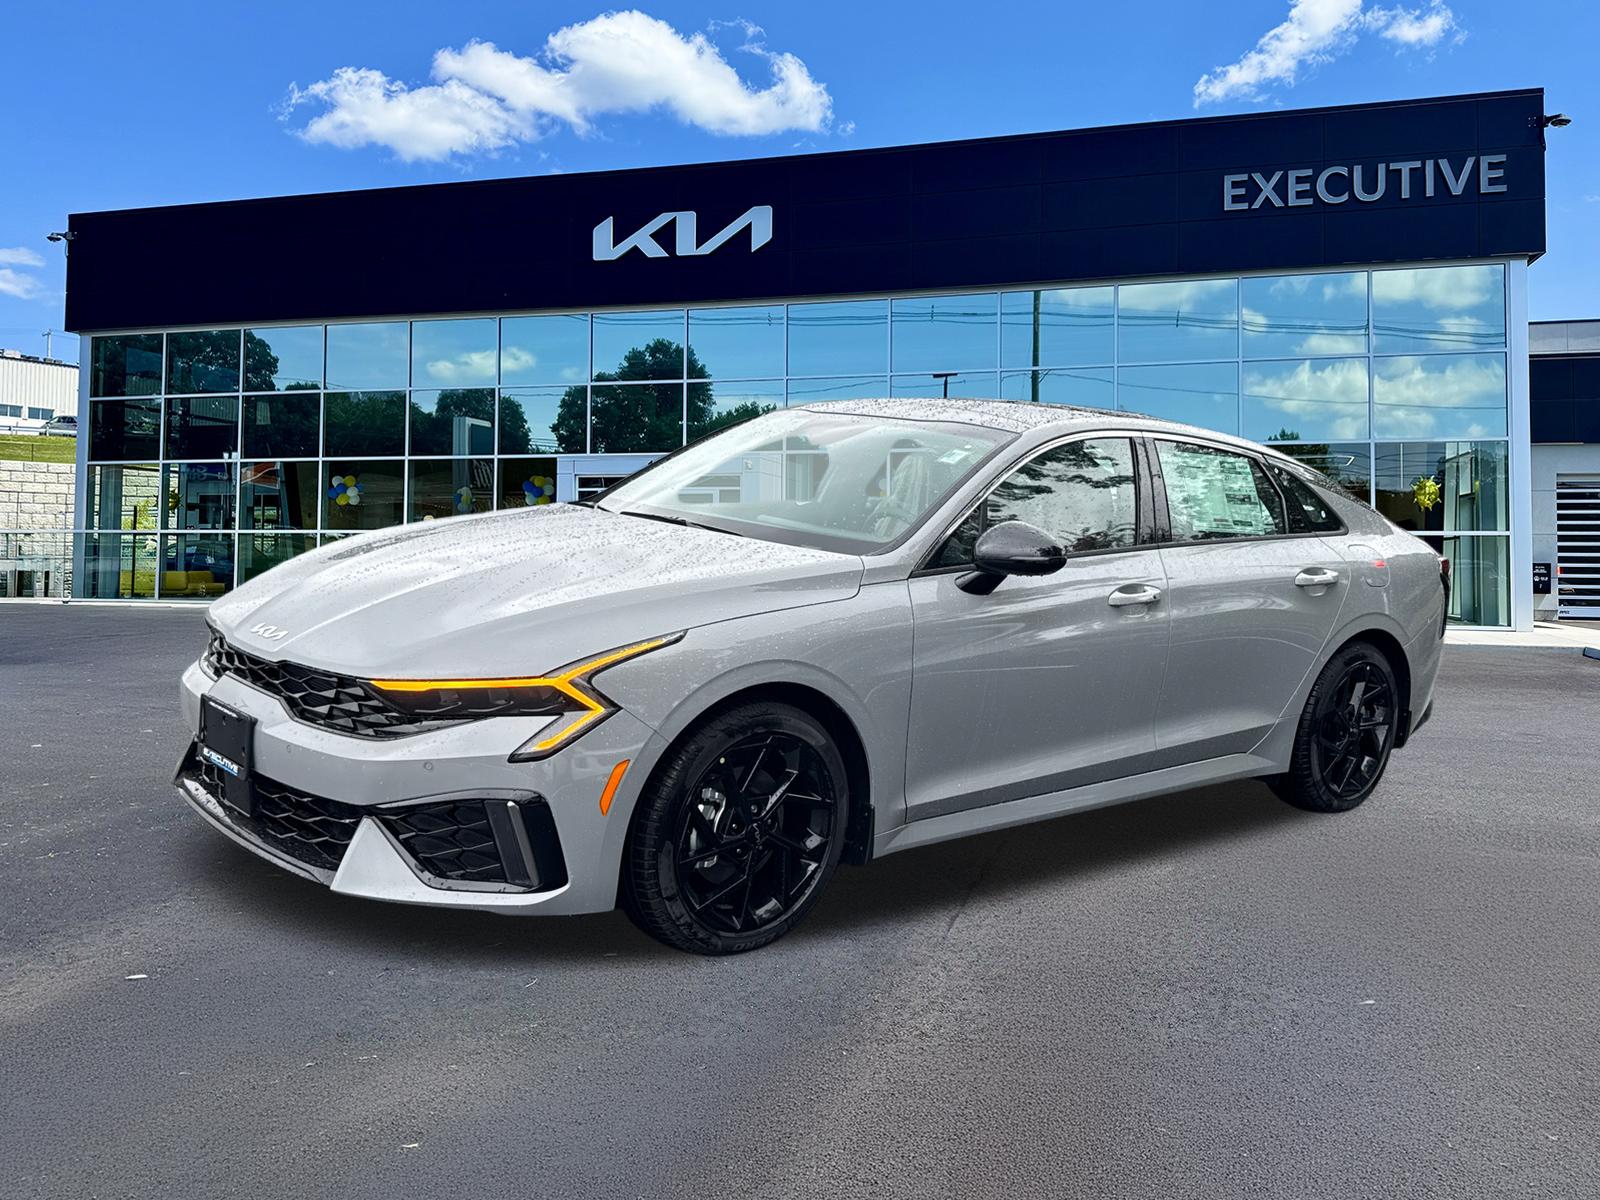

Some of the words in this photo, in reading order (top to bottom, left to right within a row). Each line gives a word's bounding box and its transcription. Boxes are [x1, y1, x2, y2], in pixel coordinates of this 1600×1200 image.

[1224, 154, 1508, 211] EXECUTIVE
[593, 205, 773, 261] KIA
[250, 621, 289, 641] KIA
